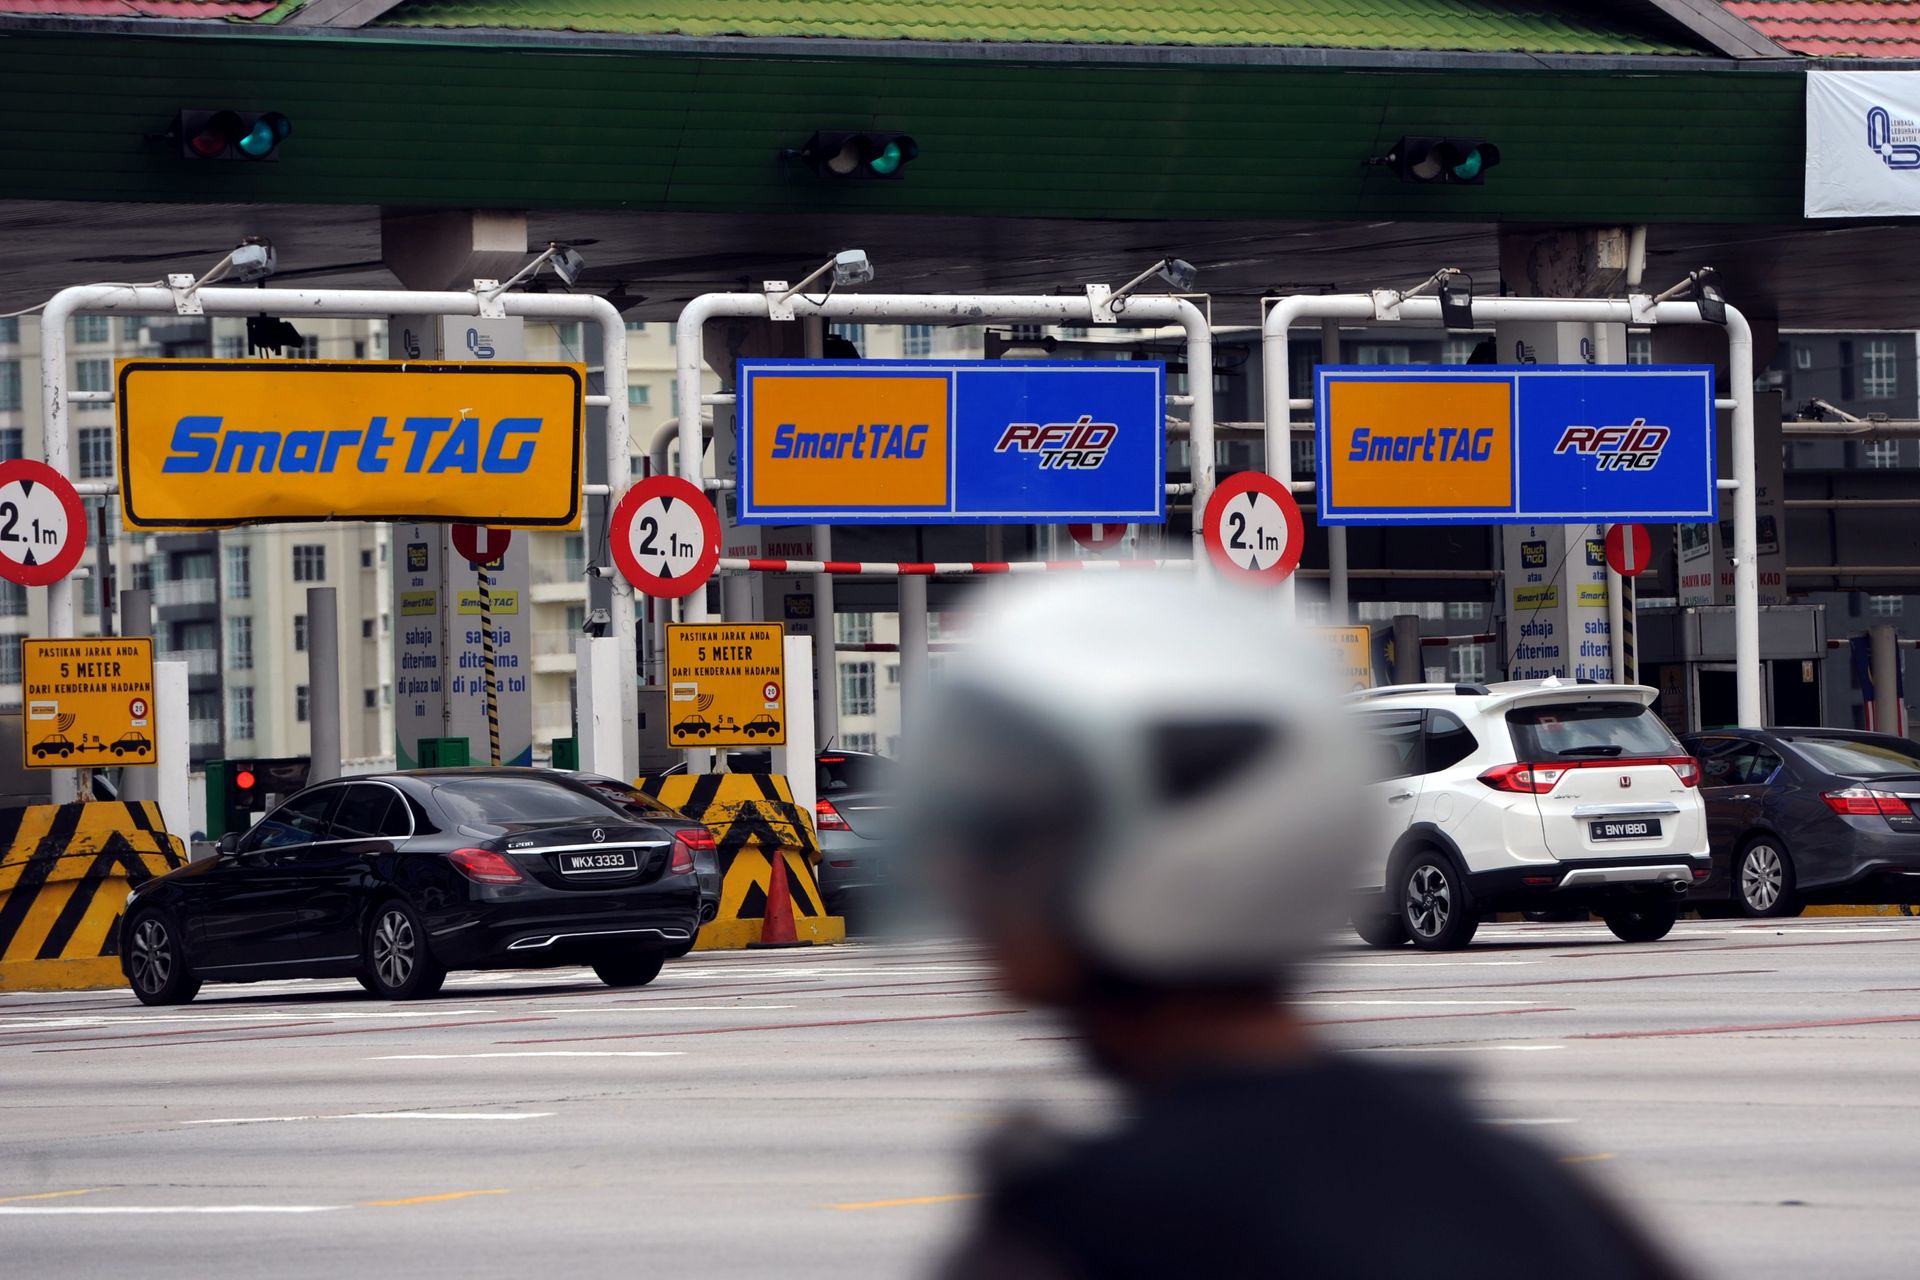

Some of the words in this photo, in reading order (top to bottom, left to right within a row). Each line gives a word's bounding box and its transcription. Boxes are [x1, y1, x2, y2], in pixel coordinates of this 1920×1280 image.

[161, 415, 543, 474] SmartTAG
[771, 423, 929, 459] SmartTAG
[1348, 427, 1494, 461] SmartTAG
[1039, 449, 1108, 469] TAG
[1596, 451, 1661, 471] TAG
[768, 544, 803, 557] HANYA
[1527, 572, 1542, 582] atau
[1760, 572, 1781, 585] KAD
[461, 598, 514, 607] SmaTAG
[1520, 619, 1553, 639] sahaja
[1585, 618, 1610, 634] saha
[406, 627, 432, 647] sahaja
[466, 627, 511, 647] saaja
[679, 632, 718, 641] PASTIKAN
[721, 632, 746, 641] JARAK
[750, 631, 770, 640] ANDA
[38, 647, 81, 657] PASTIKAN
[85, 647, 112, 657] JARAK
[116, 646, 139, 656] ANDA
[698, 647, 706, 661] 5
[712, 646, 753, 661] METER
[1516, 643, 1559, 660] diterima
[1580, 641, 1611, 657] diteri
[402, 652, 437, 669] diterima
[459, 652, 518, 668] diteima
[60, 662, 69, 678] 5
[77, 661, 121, 678] METER
[672, 667, 691, 677] DARI
[694, 667, 742, 677] KENDERAAN
[744, 666, 780, 676] HADAPAN
[1512, 667, 1522, 681] di
[1552, 665, 1565, 678] tol
[1576, 664, 1586, 679] di
[29, 684, 51, 694] DARI
[55, 683, 107, 694] KENDERAAN
[111, 682, 150, 692] HADAPAN
[398, 678, 407, 694] di
[408, 677, 429, 697] plaza
[430, 676, 441, 692] tol
[453, 676, 465, 693] di
[470, 676, 504, 697] plaa
[508, 675, 525, 692] tol
[767, 688, 775, 696] 20
[415, 700, 425, 717] ini
[718, 714, 723, 724] 5
[727, 716, 734, 724] m
[82, 733, 88, 743] 5
